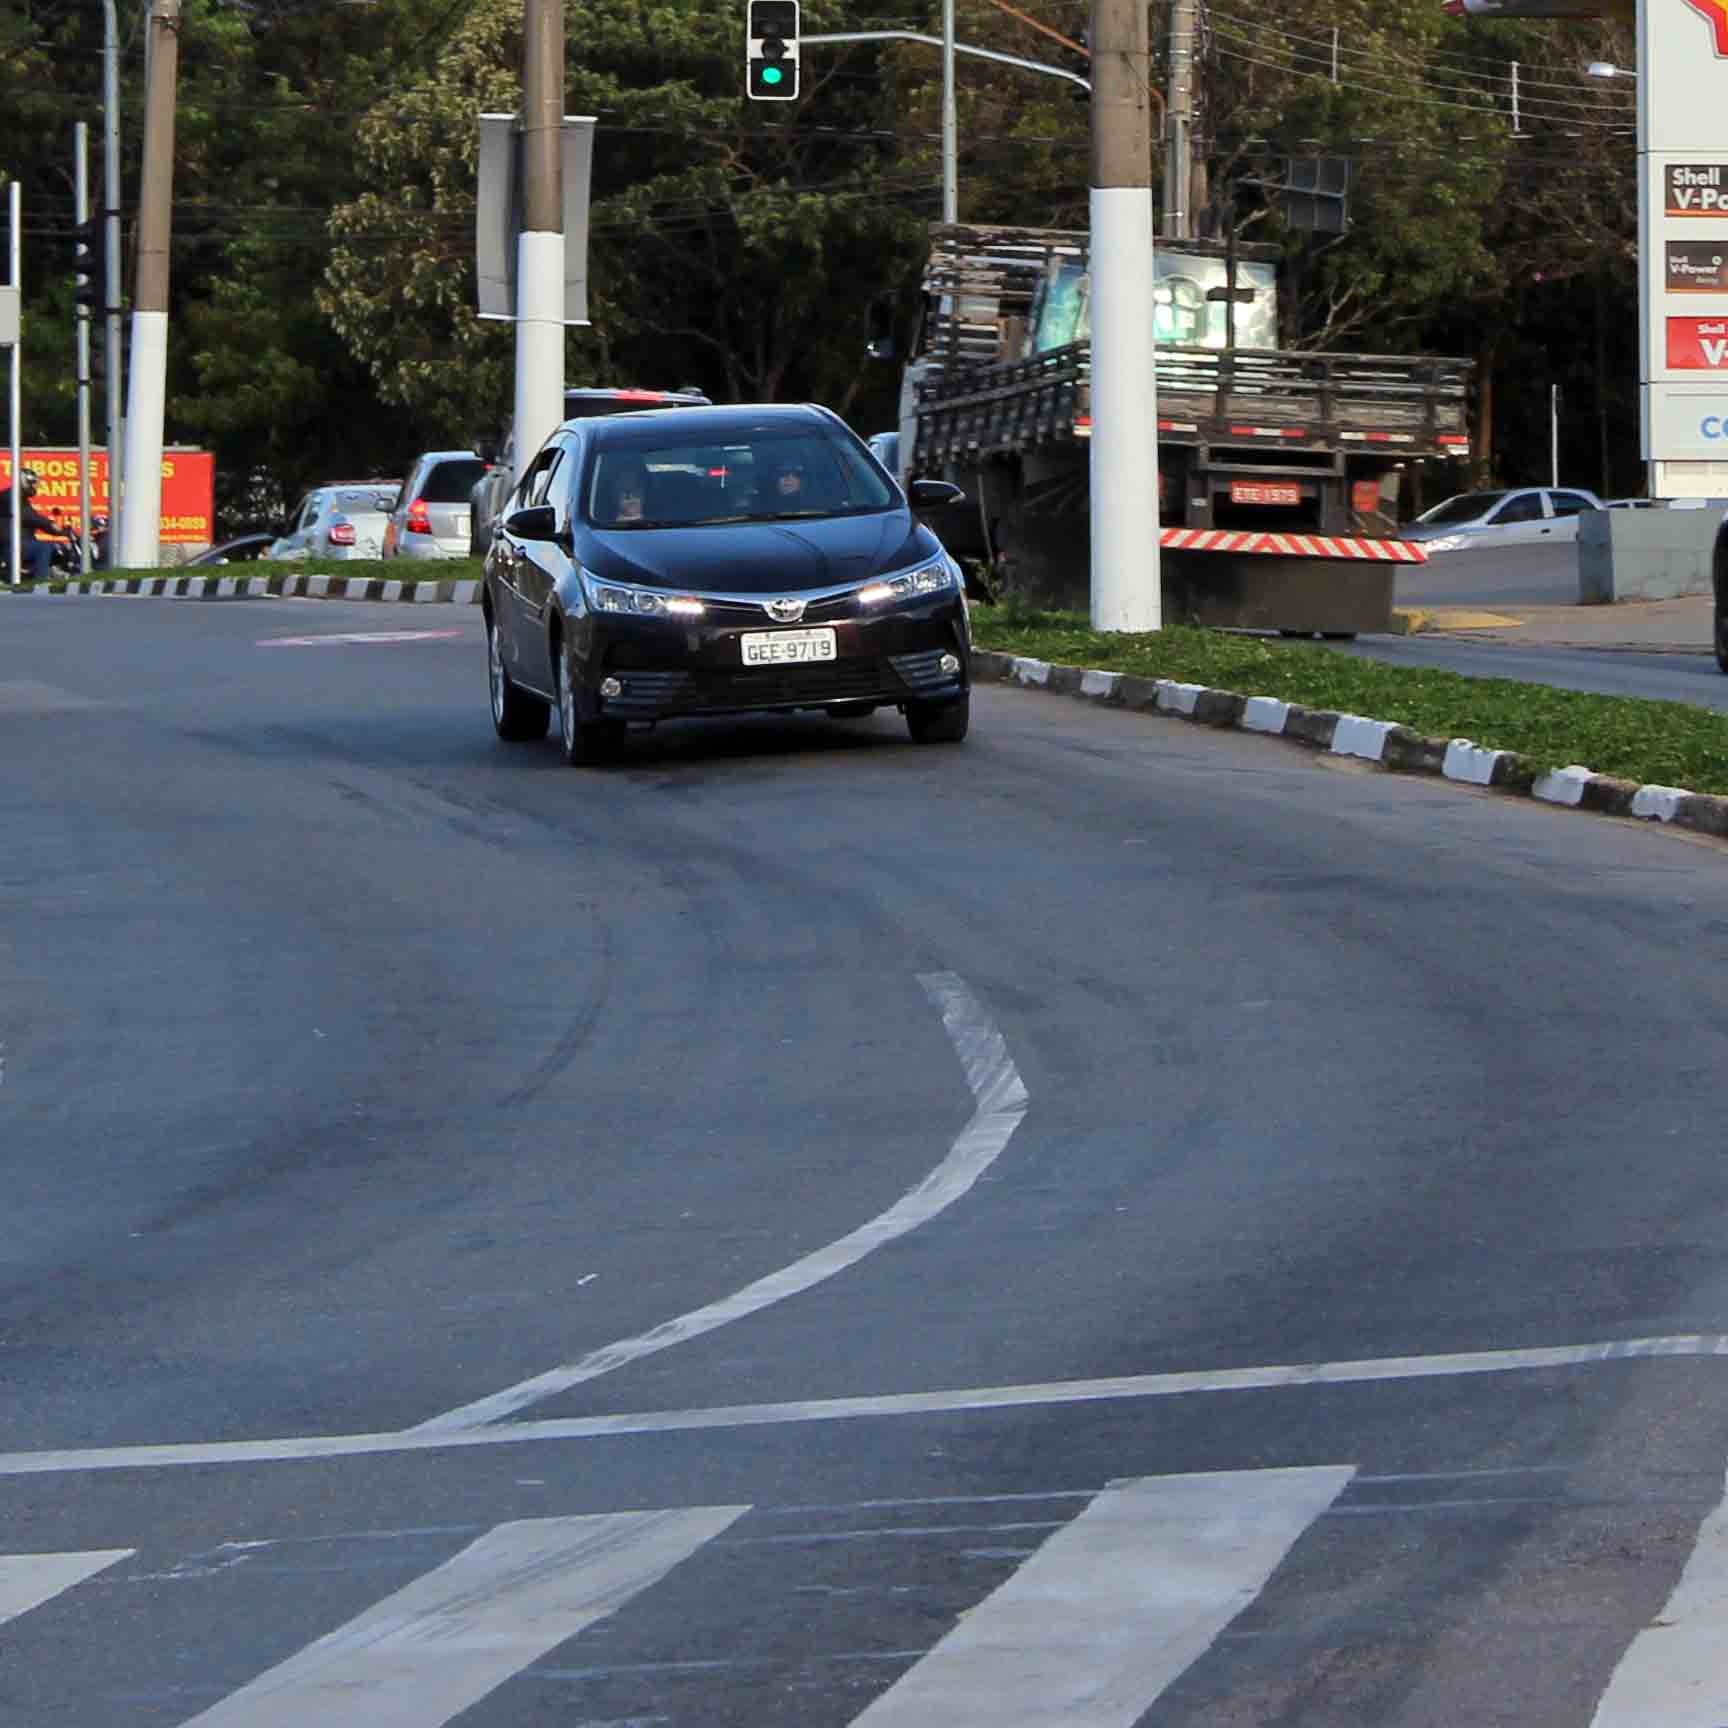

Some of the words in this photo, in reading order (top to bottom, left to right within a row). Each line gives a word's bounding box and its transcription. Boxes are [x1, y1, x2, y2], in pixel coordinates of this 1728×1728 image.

[1672, 168, 1721, 186] Shell
[0, 459, 77, 479] TBOS
[746, 639, 832, 662] GEE-9719
